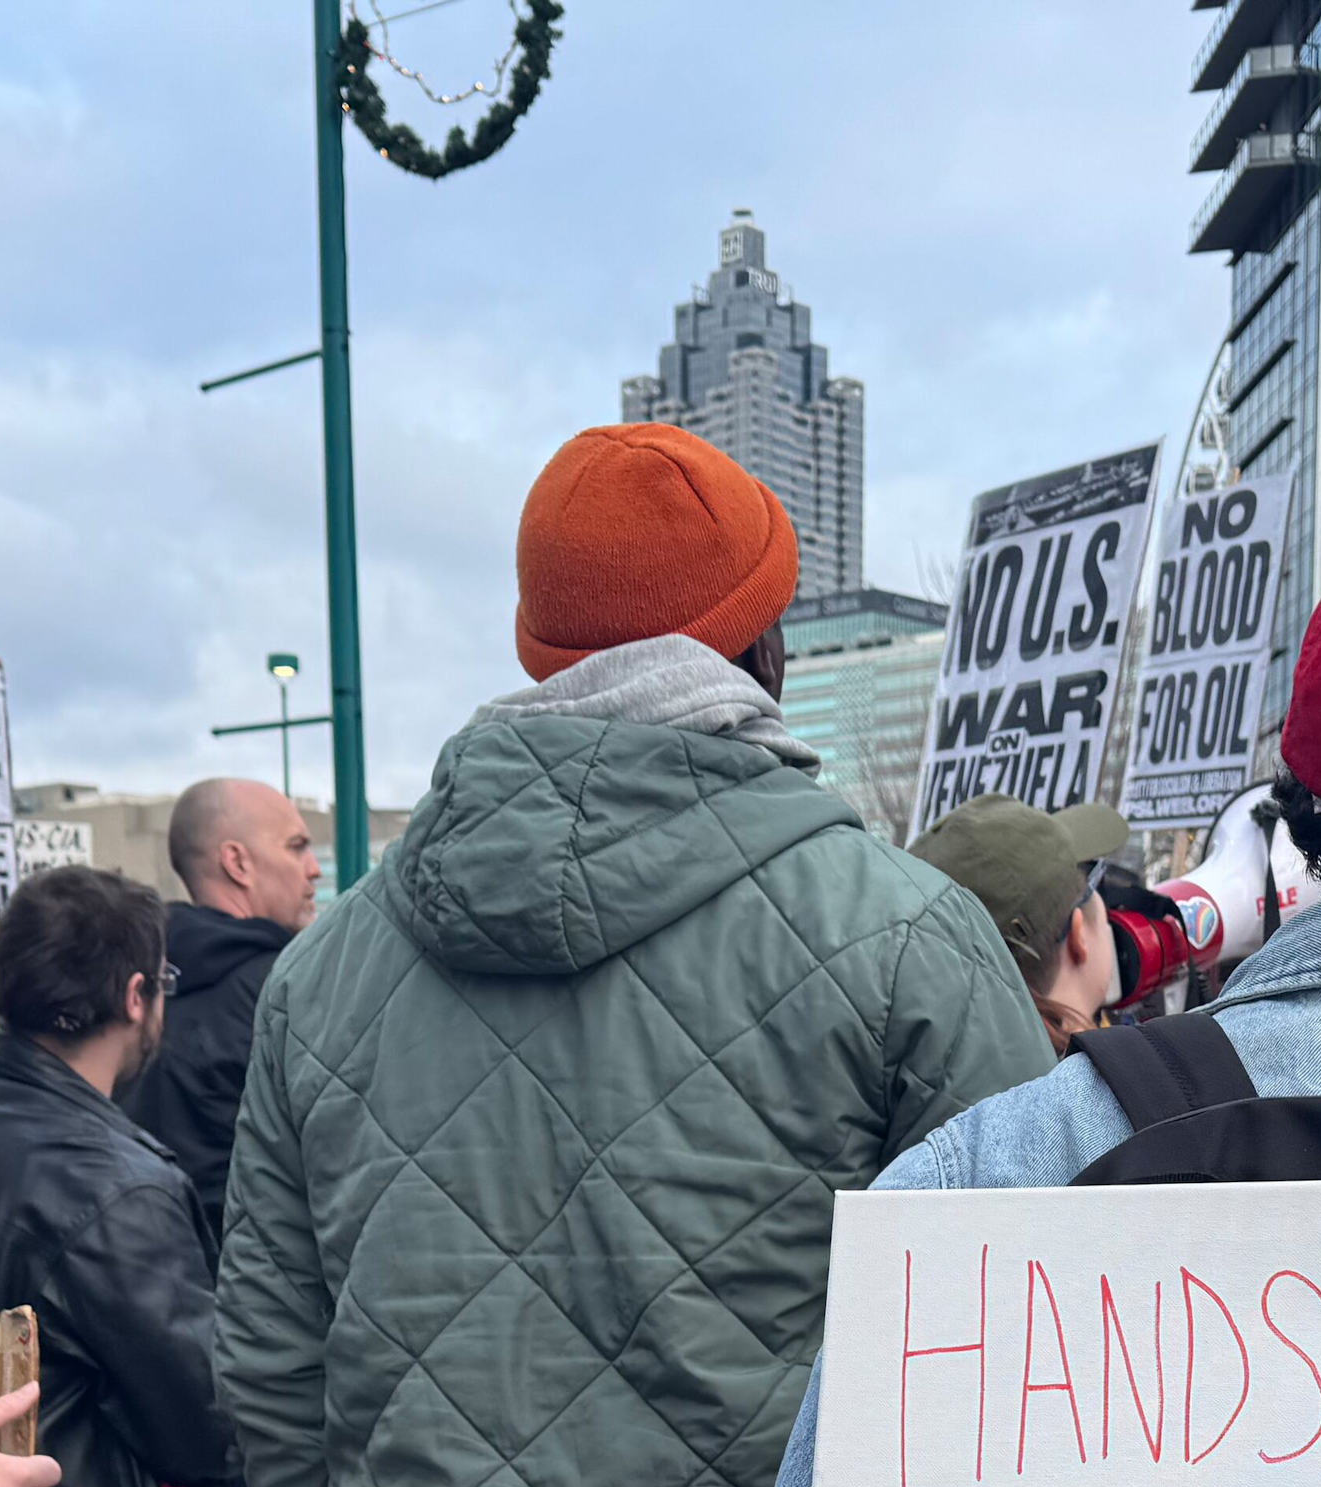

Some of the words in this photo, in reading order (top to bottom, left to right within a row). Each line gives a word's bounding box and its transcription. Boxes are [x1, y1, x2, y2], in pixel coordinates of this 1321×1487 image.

[1182, 490, 1257, 549] NO
[944, 544, 1023, 678] NO
[1019, 521, 1121, 662] U.S.
[1151, 540, 1271, 656] BLOOD
[934, 669, 1108, 752] WAR
[990, 732, 1020, 752] ON
[1133, 671, 1198, 766] FOR
[1197, 661, 1252, 759] OIL
